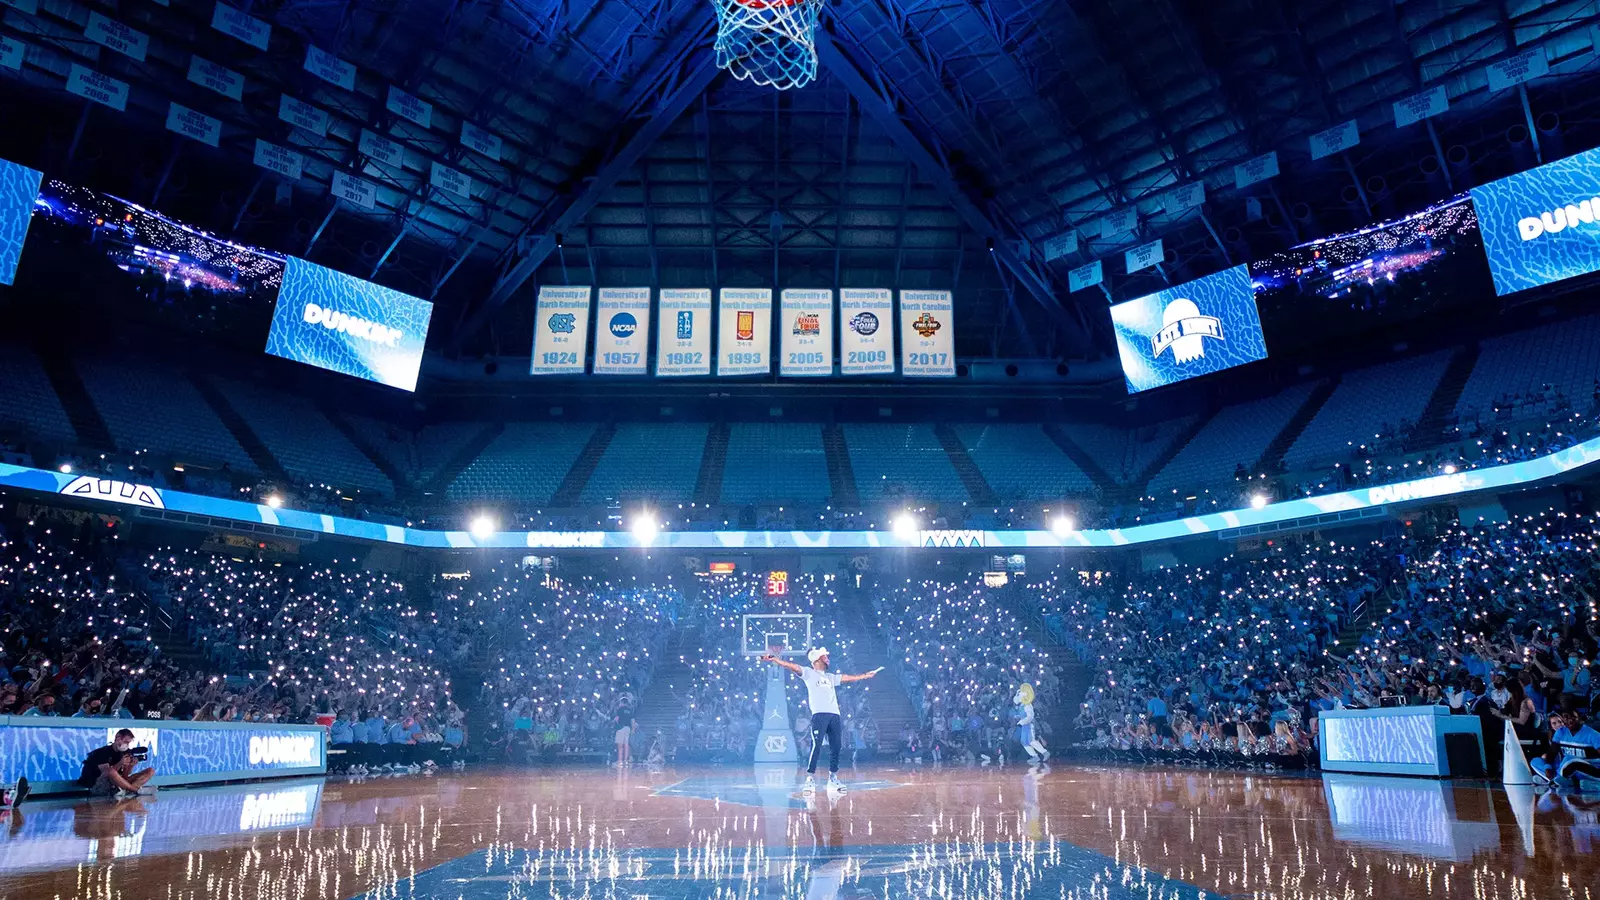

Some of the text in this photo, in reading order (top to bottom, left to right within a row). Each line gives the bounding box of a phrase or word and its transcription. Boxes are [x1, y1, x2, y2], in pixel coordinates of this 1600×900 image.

[105, 35, 128, 52] 1991
[84, 86, 110, 102] 2008
[267, 159, 288, 173] 2016
[345, 189, 363, 203] 2017
[1138, 253, 1151, 263] 2017
[542, 291, 578, 299] University
[602, 291, 638, 299] University
[664, 291, 700, 299] University
[724, 291, 760, 299] University
[844, 291, 879, 299] University
[612, 324, 637, 332] NCAA
[542, 352, 577, 364] 1924
[603, 352, 640, 364] 1957
[667, 352, 703, 365] 1982
[728, 352, 761, 364] 1993
[789, 352, 823, 364] 2005
[848, 350, 886, 363] 2009
[909, 353, 948, 365] 2017
[768, 580, 785, 595] 30
[147, 710, 161, 718] POSS
